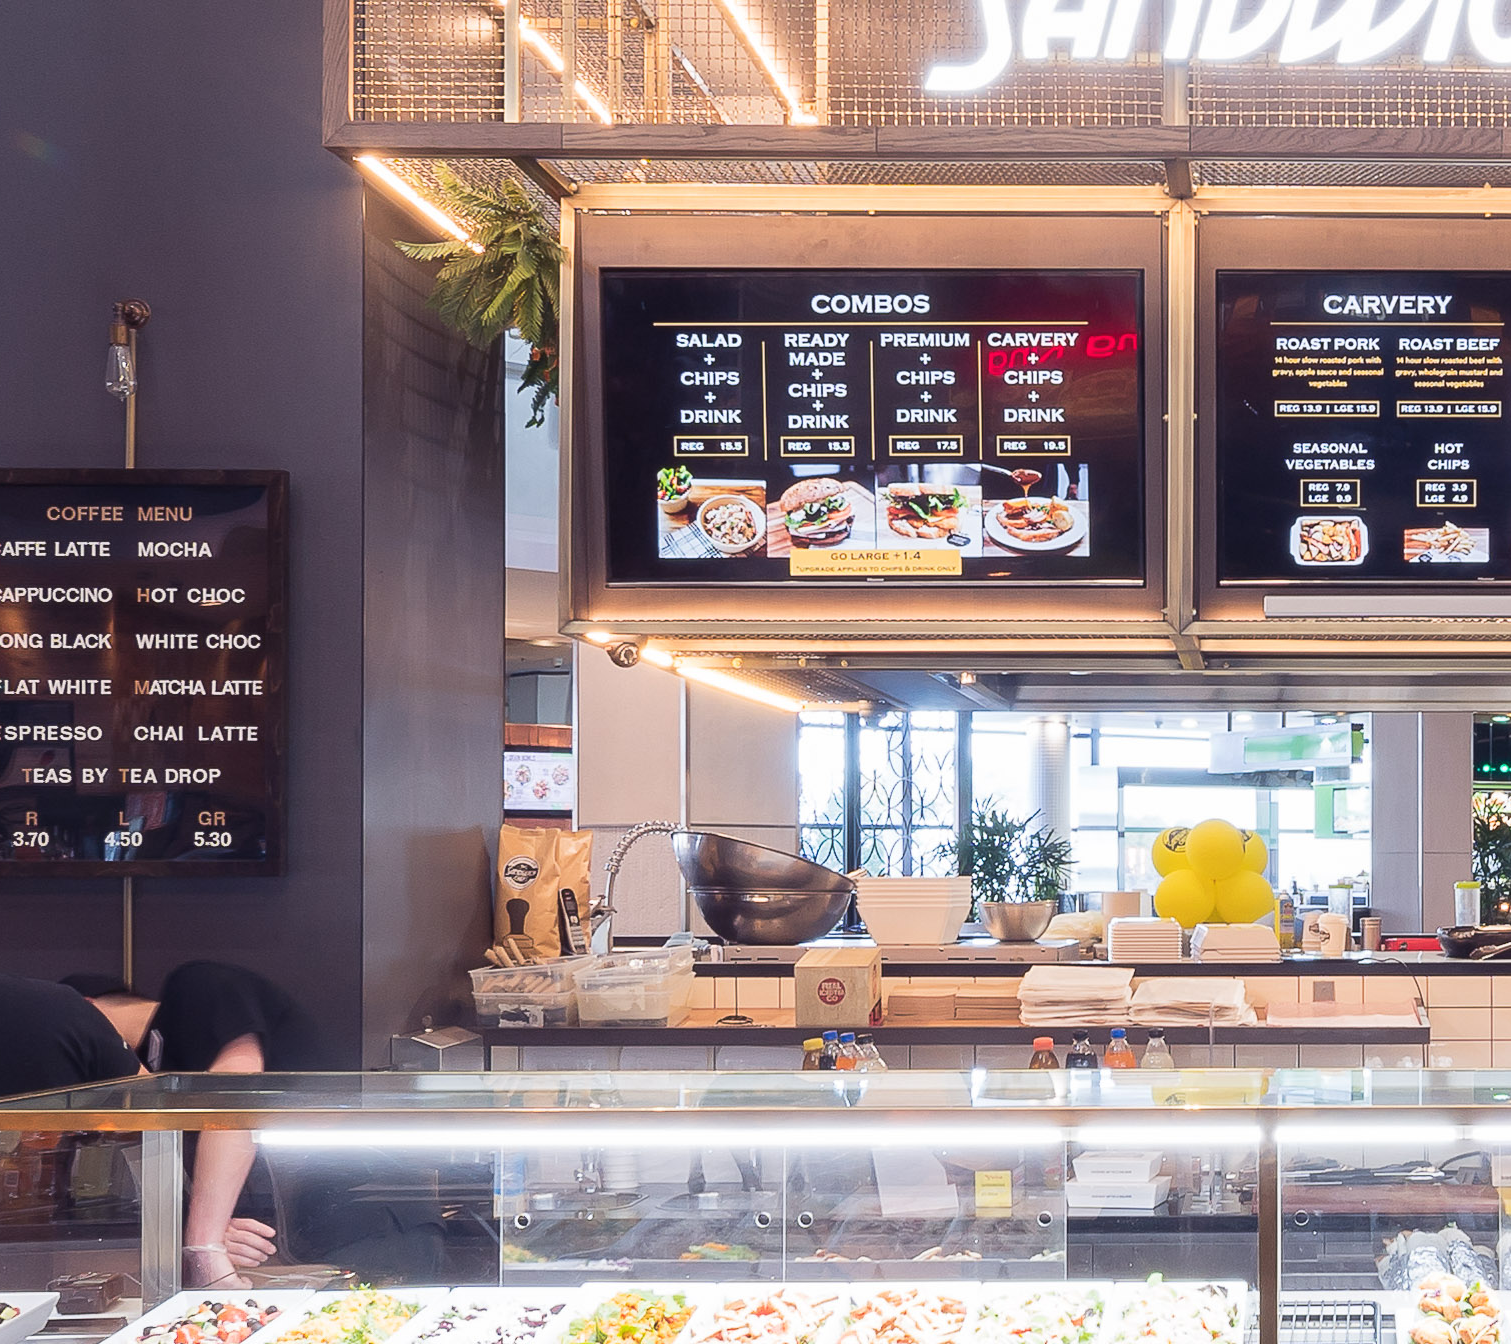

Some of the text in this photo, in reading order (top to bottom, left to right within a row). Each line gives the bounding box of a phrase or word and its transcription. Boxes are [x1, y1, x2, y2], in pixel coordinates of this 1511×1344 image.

[811, 295, 930, 314] COMBOS
[1323, 295, 1451, 315] CARVERY
[676, 334, 742, 347] SALAD
[785, 334, 849, 347] READY
[880, 334, 970, 347] PREMIUM
[988, 333, 1079, 346] CARVERY
[1276, 338, 1380, 350] ROAST PORK
[1399, 338, 1500, 350] ROAST BEEF
[789, 352, 845, 366] MADE
[680, 372, 740, 385] CHIPS
[897, 371, 955, 384] CHIPS
[1004, 371, 1063, 384] CHIPS
[788, 384, 847, 397] CHIPS
[680, 410, 742, 423] DRINK
[788, 415, 849, 429] DRINK
[897, 409, 957, 423] DRINK
[1004, 409, 1065, 422] DRINK
[681, 442, 704, 450] REG
[788, 442, 811, 450] REG
[897, 442, 957, 450] REG 17.5
[1004, 442, 1065, 450] REG 19.5
[1293, 443, 1367, 454] SEASONAL
[1435, 443, 1463, 454] HOT
[1285, 460, 1375, 470] VEGETABLES
[1427, 460, 1470, 470] CHIPS
[47, 507, 193, 522] COFFEE MENU
[54, 542, 110, 557] LATTE
[138, 542, 212, 557] MOCHA
[137, 588, 245, 603] HOT CHOC
[51, 634, 112, 649] BLACK
[136, 634, 260, 649] WHITE CHOC
[48, 680, 112, 695] WHITE
[134, 681, 263, 695] MATCHA LATTE
[134, 726, 258, 741] CHAI LATTE
[22, 769, 221, 783] TEAS BY TEA DROP
[26, 812, 38, 826] R
[119, 812, 129, 826] L
[199, 812, 226, 826] GR
[13, 832, 49, 847] 3.70
[104, 832, 142, 847] 4.50
[194, 832, 232, 847] 5.30
